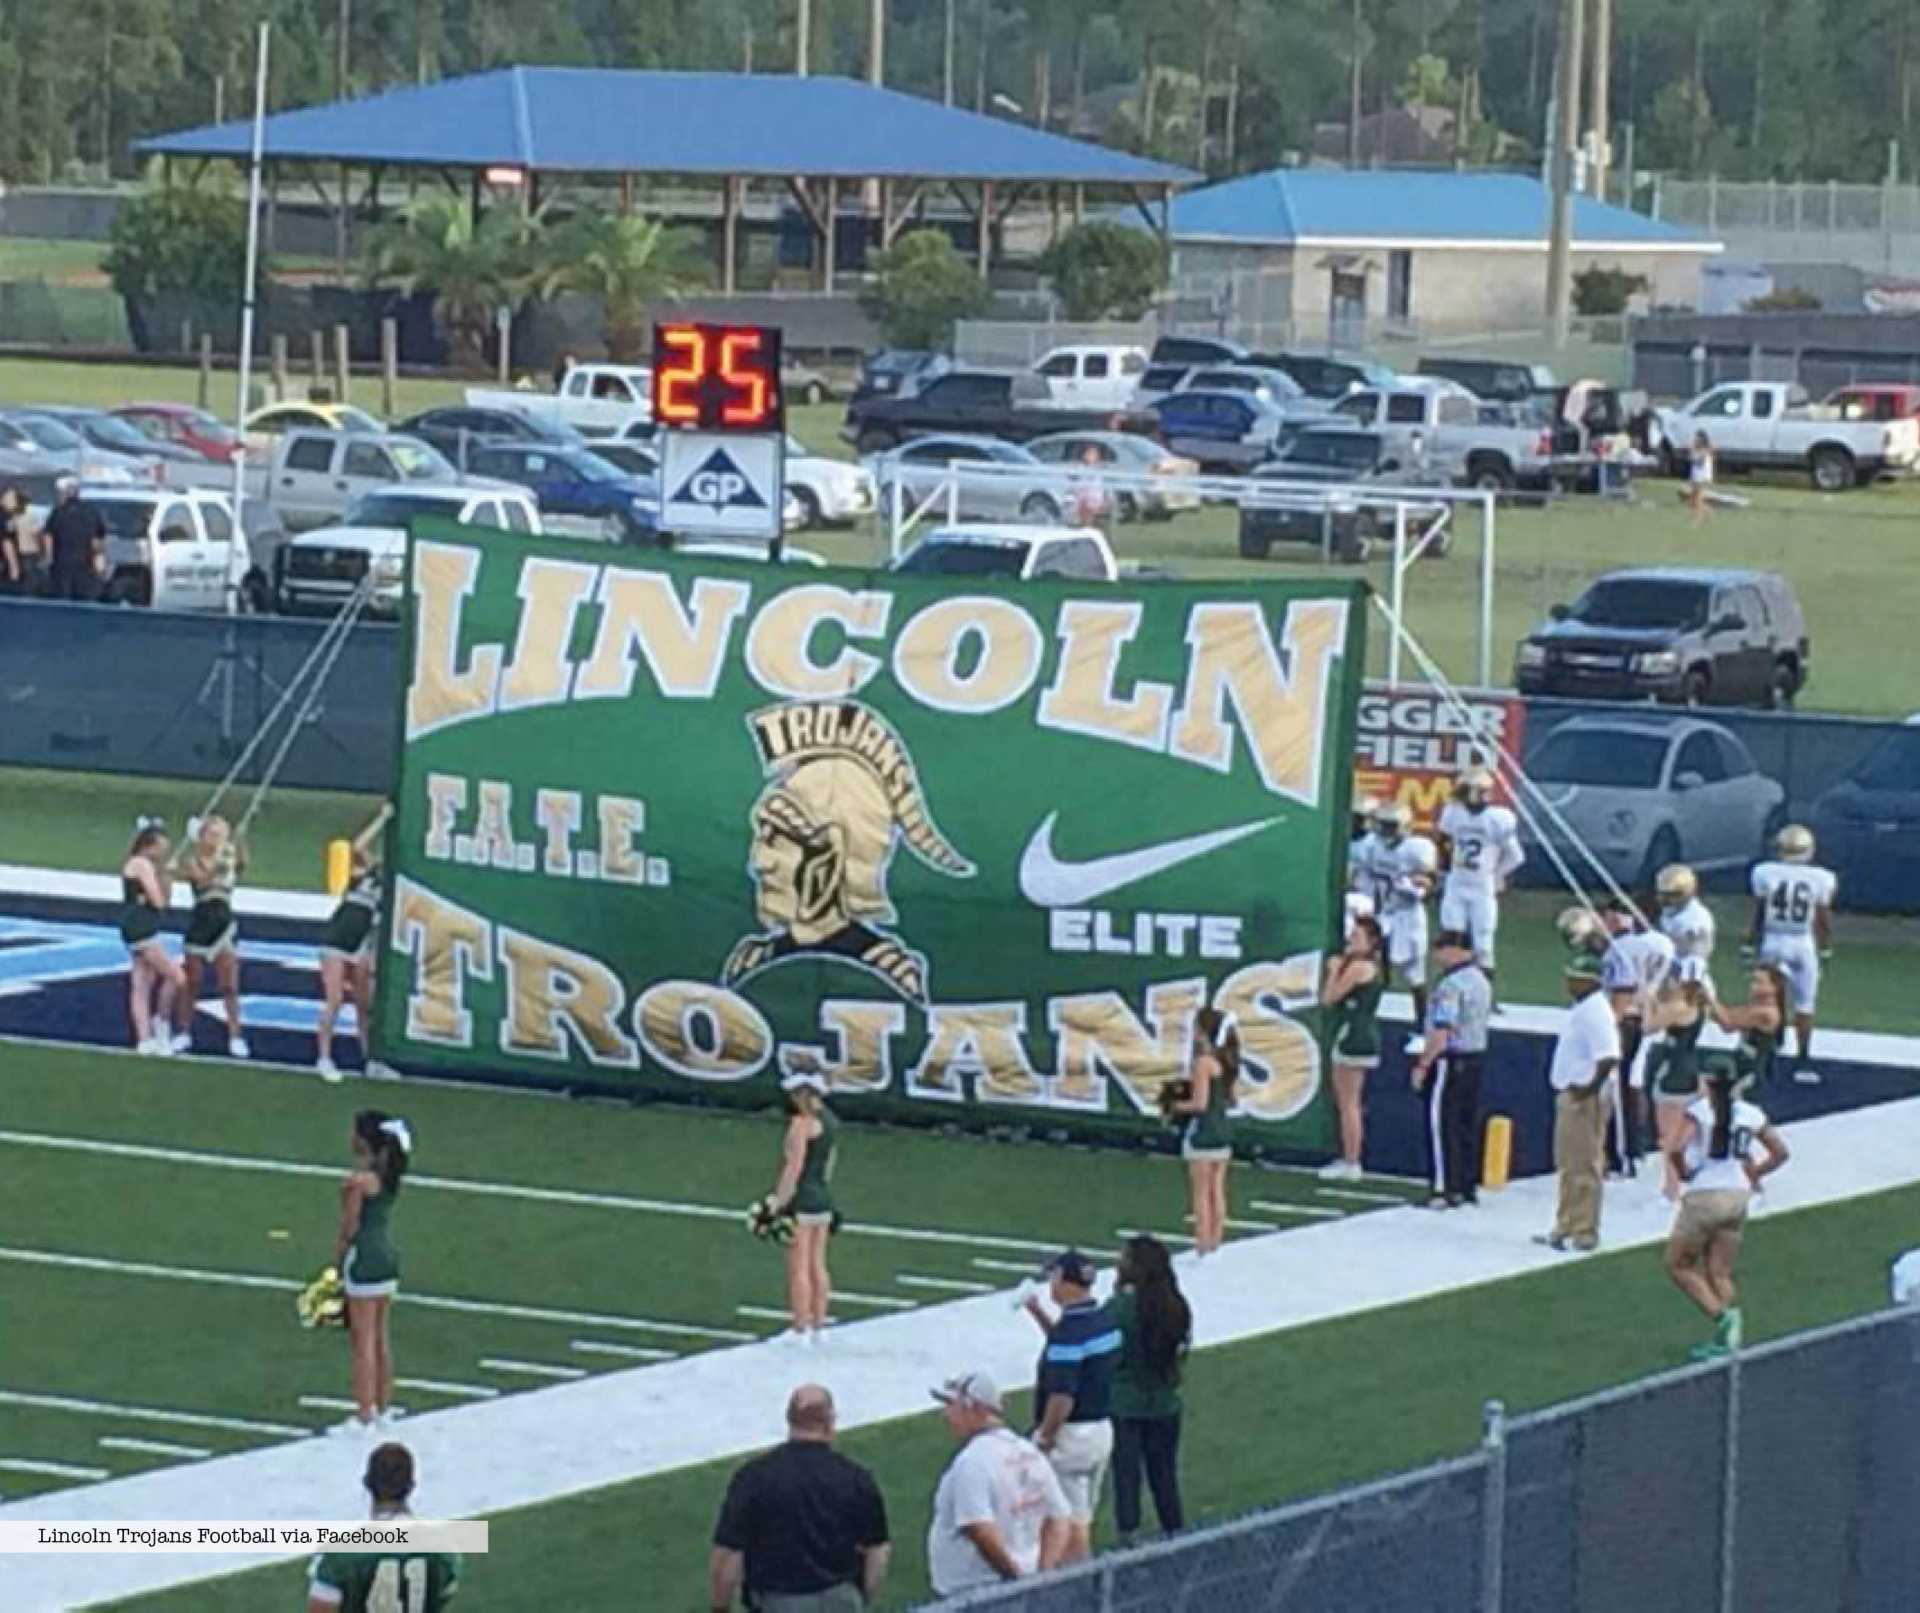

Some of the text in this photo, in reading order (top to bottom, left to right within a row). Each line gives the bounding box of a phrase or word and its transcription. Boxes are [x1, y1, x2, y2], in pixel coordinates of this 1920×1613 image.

[659, 330, 764, 421] 25
[690, 470, 746, 503] GP
[406, 540, 1349, 808] LINCOLN
[755, 703, 911, 797] TROJANS
[425, 773, 669, 885] F.A.T.E.
[1049, 910, 1242, 958] ELITE
[1771, 880, 1811, 923] 46
[392, 873, 1321, 1121] TROJANS
[366, 1557, 427, 1613] 41
